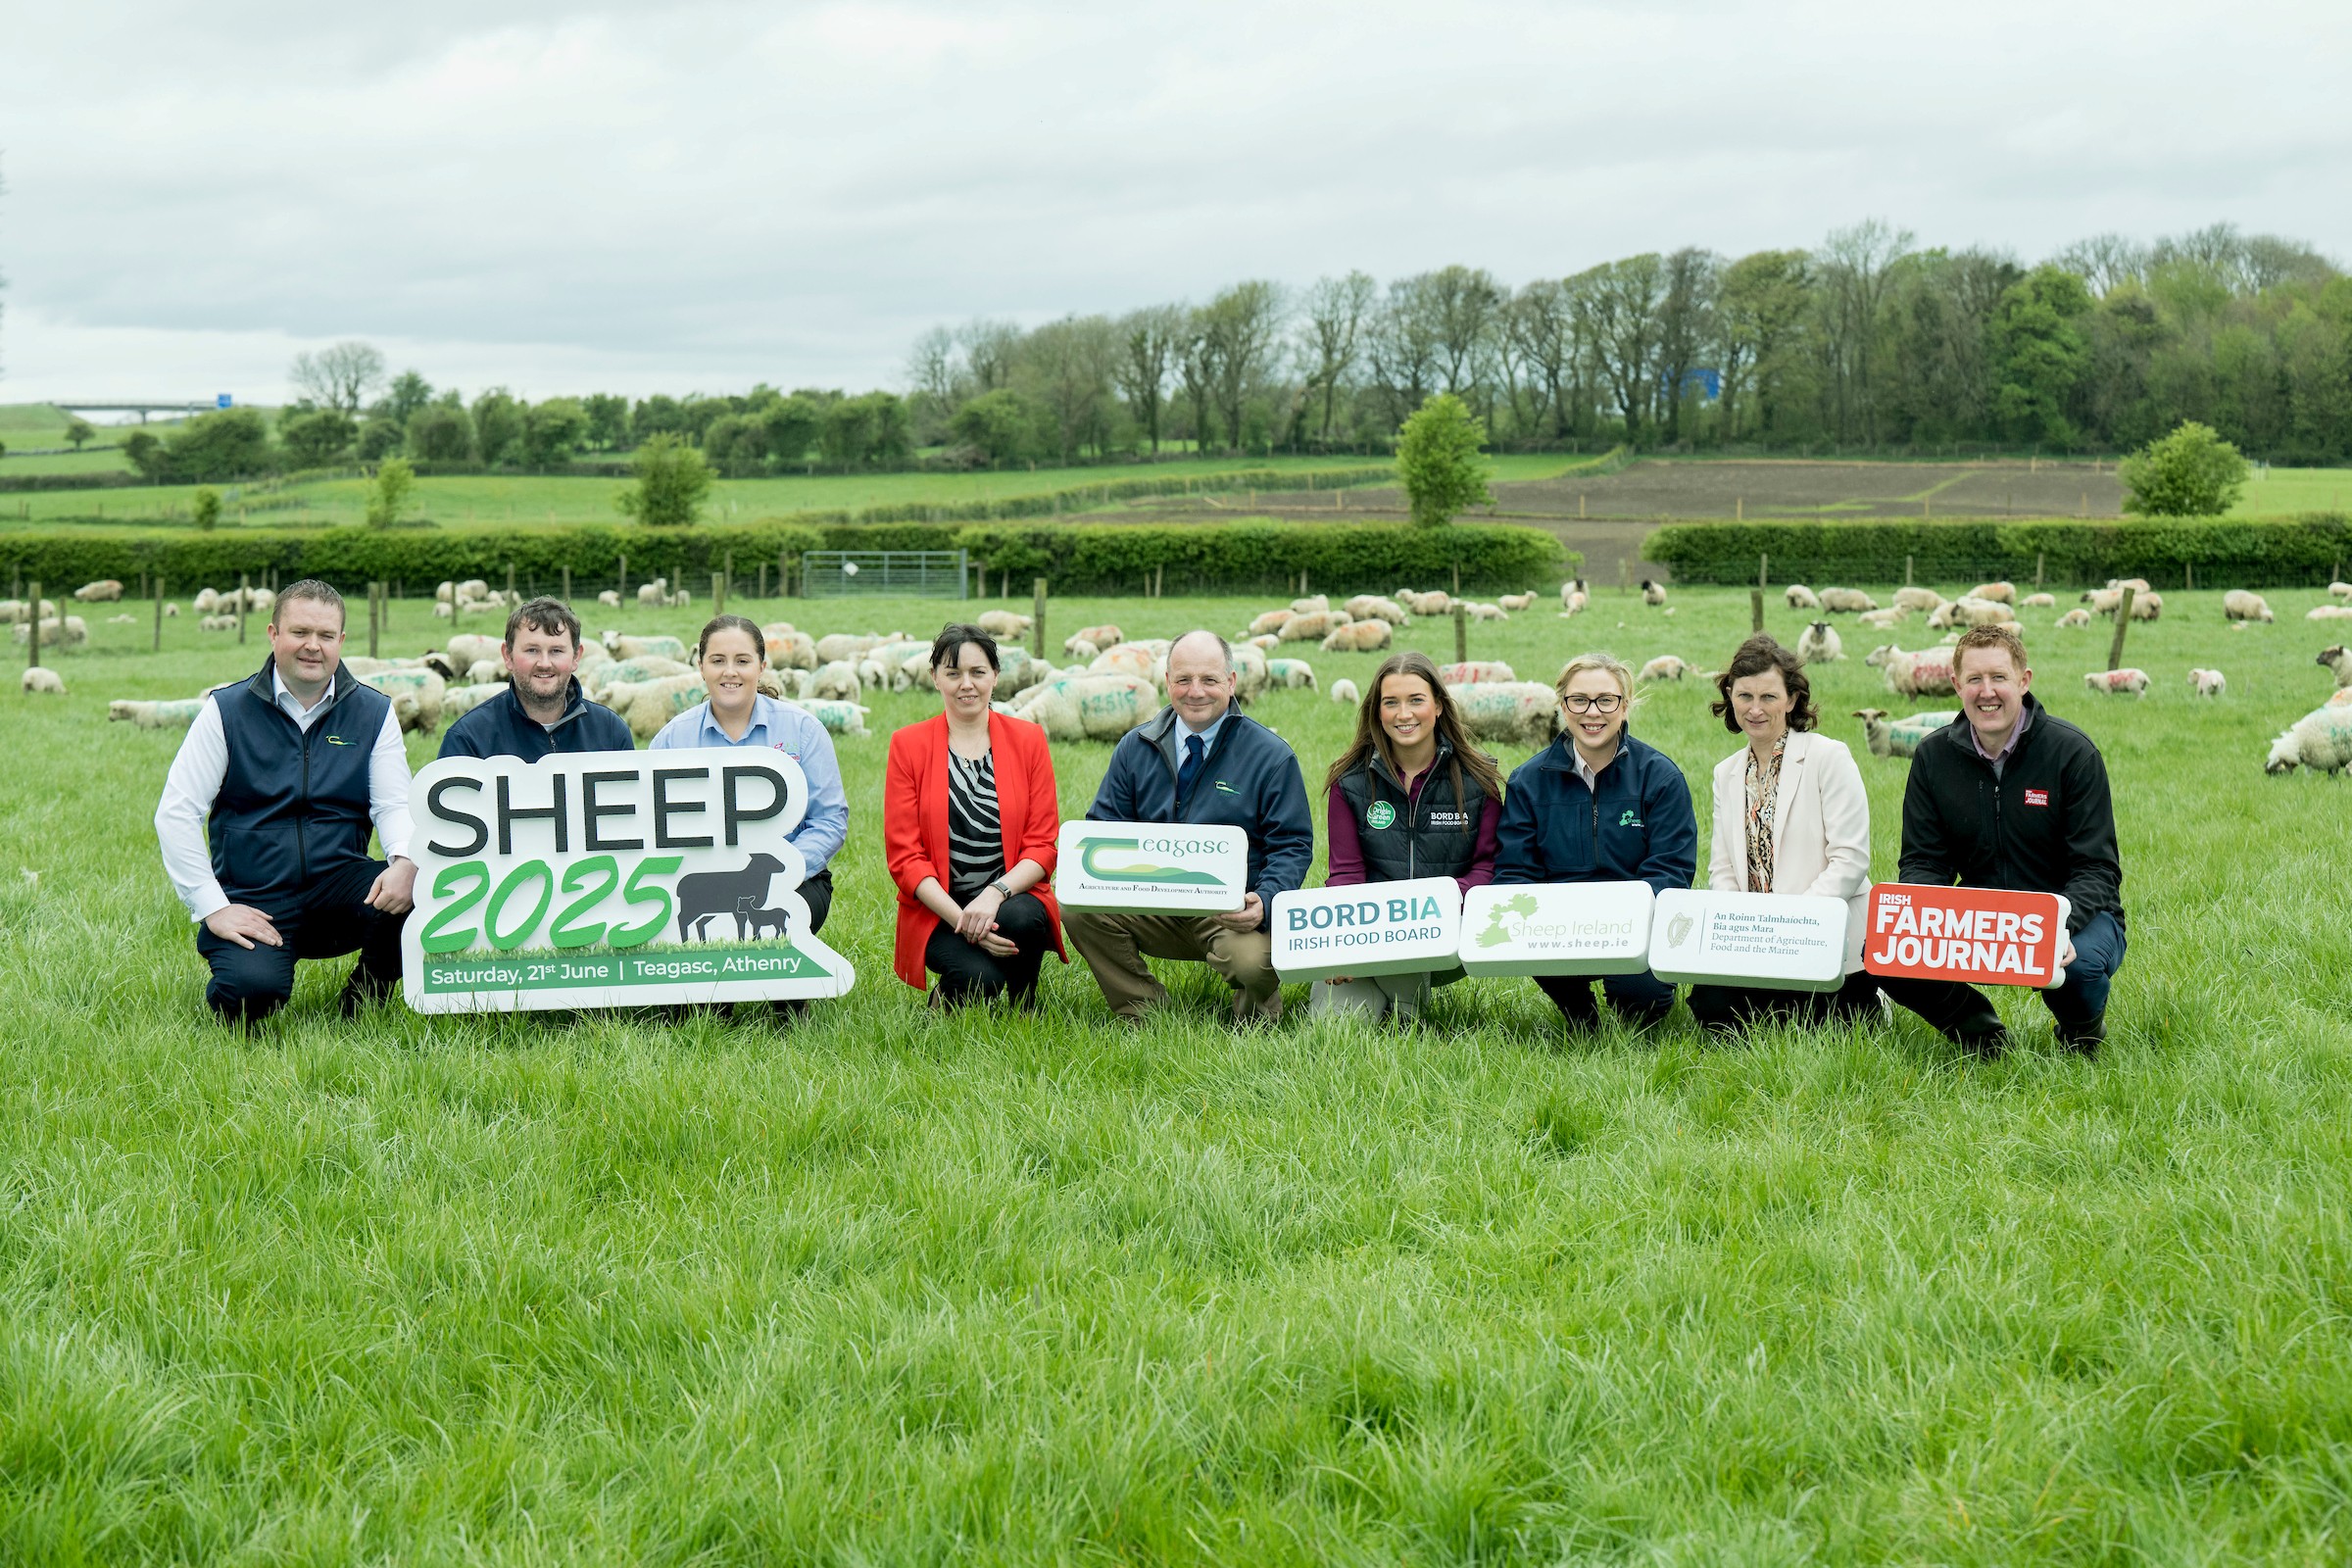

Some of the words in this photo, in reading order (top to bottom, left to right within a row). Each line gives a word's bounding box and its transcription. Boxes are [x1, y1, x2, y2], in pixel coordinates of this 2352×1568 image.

[427, 765, 788, 858] SHEEP
[1133, 884, 1151, 893] FOOD
[1151, 885, 1194, 895] DEVELOPMENT
[1194, 887, 1228, 896] AUTHORITY
[1879, 894, 1911, 906] IRISH
[420, 855, 684, 954] 2025
[1287, 902, 1381, 931] BORD
[1387, 896, 1443, 923] BIA
[1729, 912, 1755, 922] Roinn
[1876, 905, 2045, 944] FARMERS
[1511, 921, 1567, 940] Sheep
[1572, 919, 1633, 936] Ireland
[1713, 922, 1727, 931] Bia
[1729, 924, 1750, 934] agus
[1751, 924, 1774, 933] Mara
[1289, 936, 1330, 952] IRISH
[1335, 931, 1380, 948] FOOD
[1385, 926, 1442, 943] BOARD
[1528, 938, 1629, 950] www.sheep.ie
[1710, 942, 1733, 952] Food
[1734, 944, 1750, 953] and
[1752, 944, 1767, 954] the
[1768, 946, 1799, 956] Marine
[1712, 932, 1763, 944] Department
[1765, 935, 1777, 944] of
[1776, 936, 1828, 948] Agriculture,
[1873, 936, 2044, 975] JOURNAL
[431, 965, 523, 986] Saturday,
[560, 963, 609, 980] June
[633, 960, 718, 979] Teagasc,
[721, 956, 802, 974] Athenry
